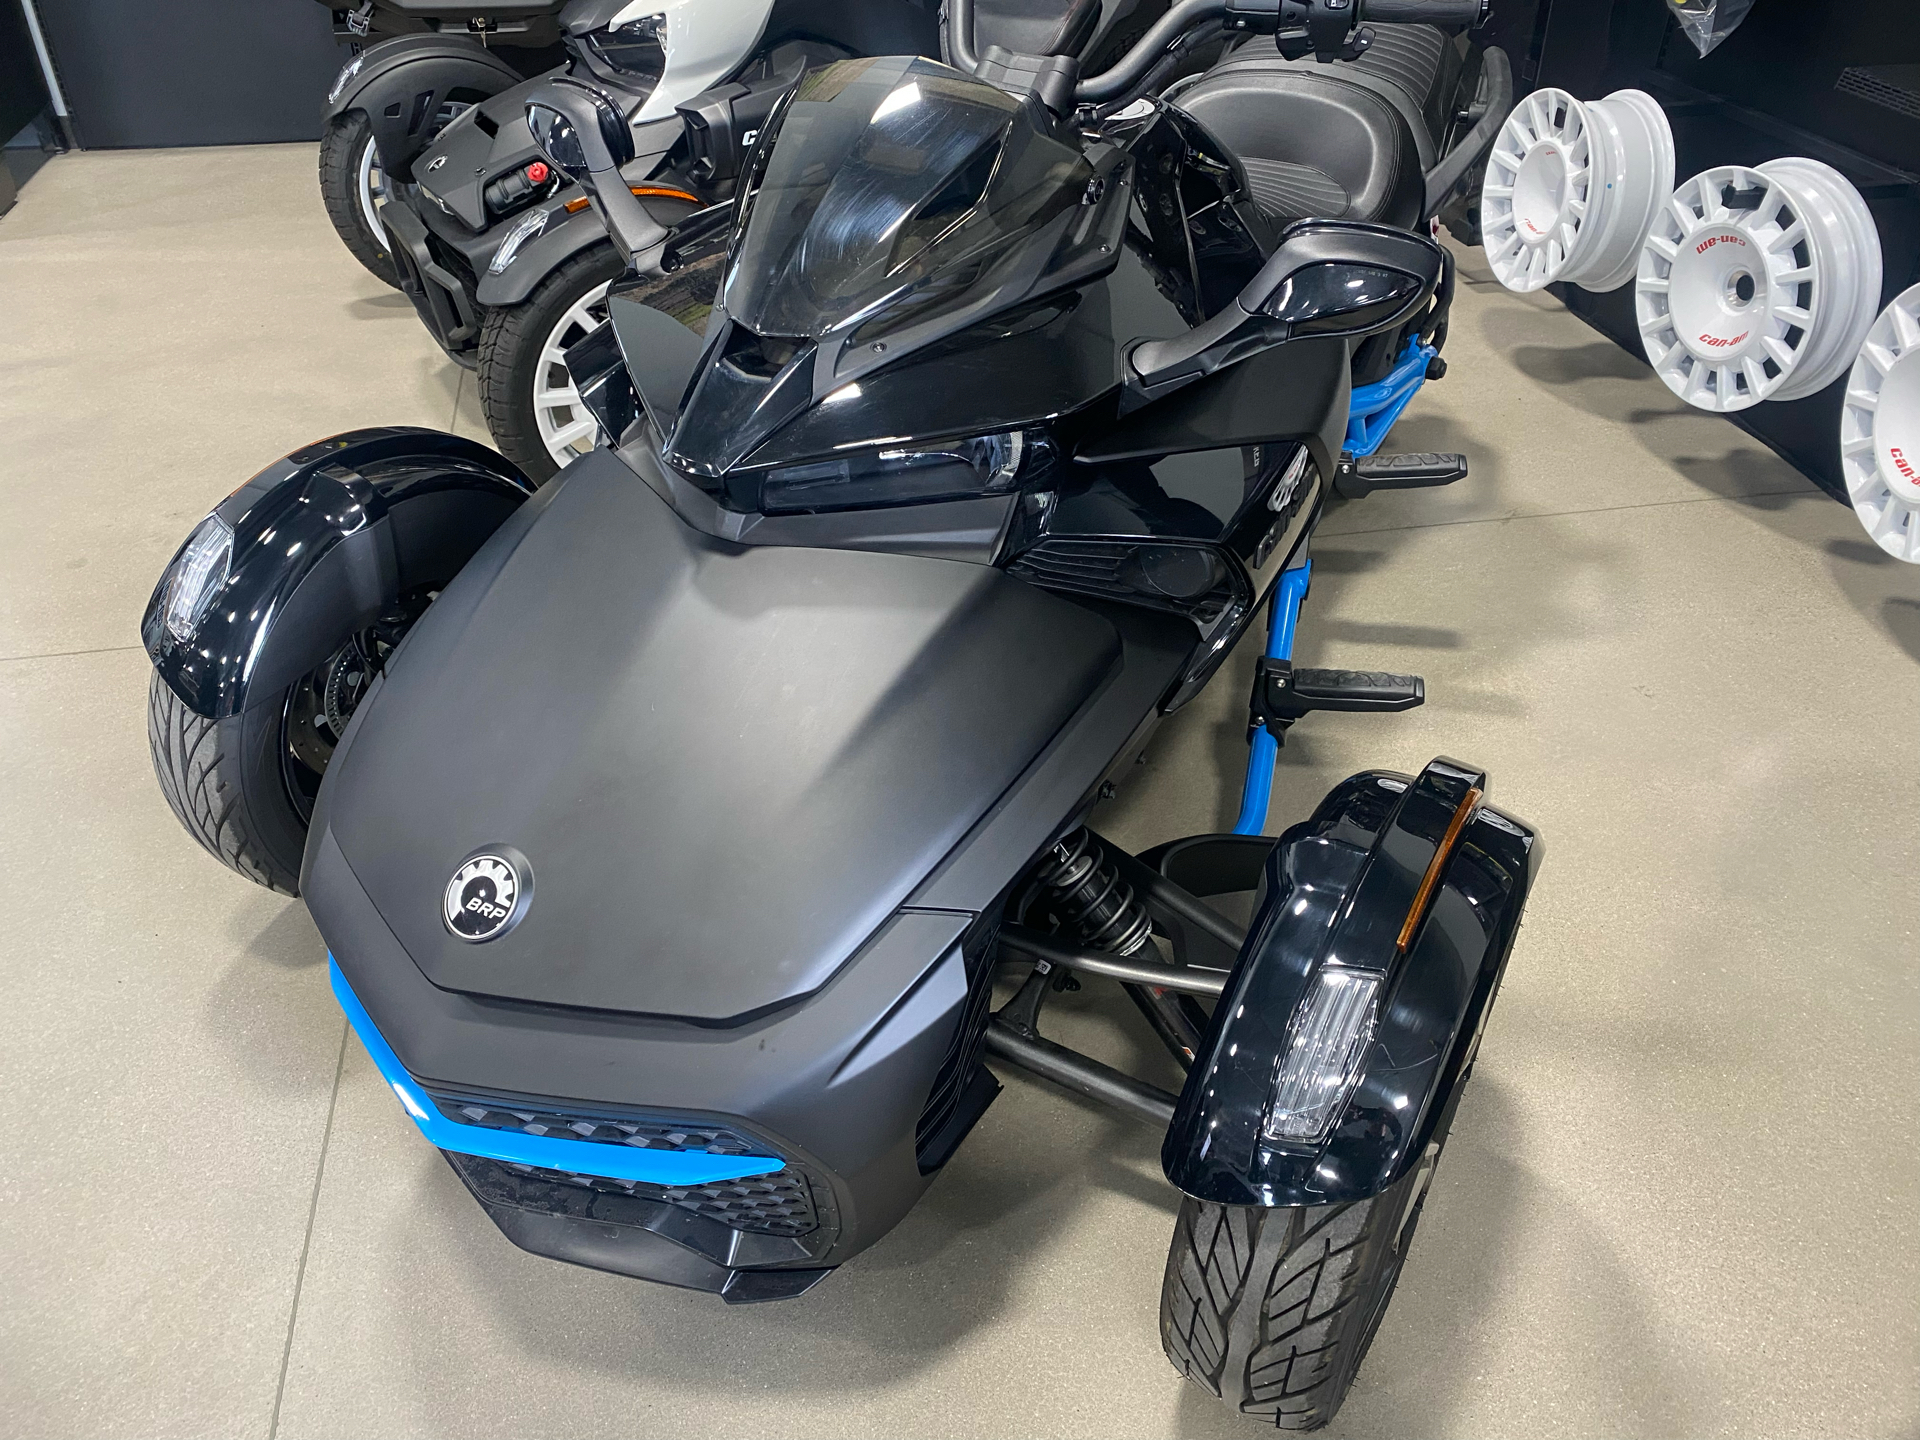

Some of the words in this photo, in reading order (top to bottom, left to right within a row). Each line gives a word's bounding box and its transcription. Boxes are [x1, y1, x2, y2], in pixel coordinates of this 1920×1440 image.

[1696, 235, 1746, 254] can-am
[1699, 330, 1749, 347] can-am
[1890, 448, 1920, 487] can-a
[465, 897, 507, 919] BRP
